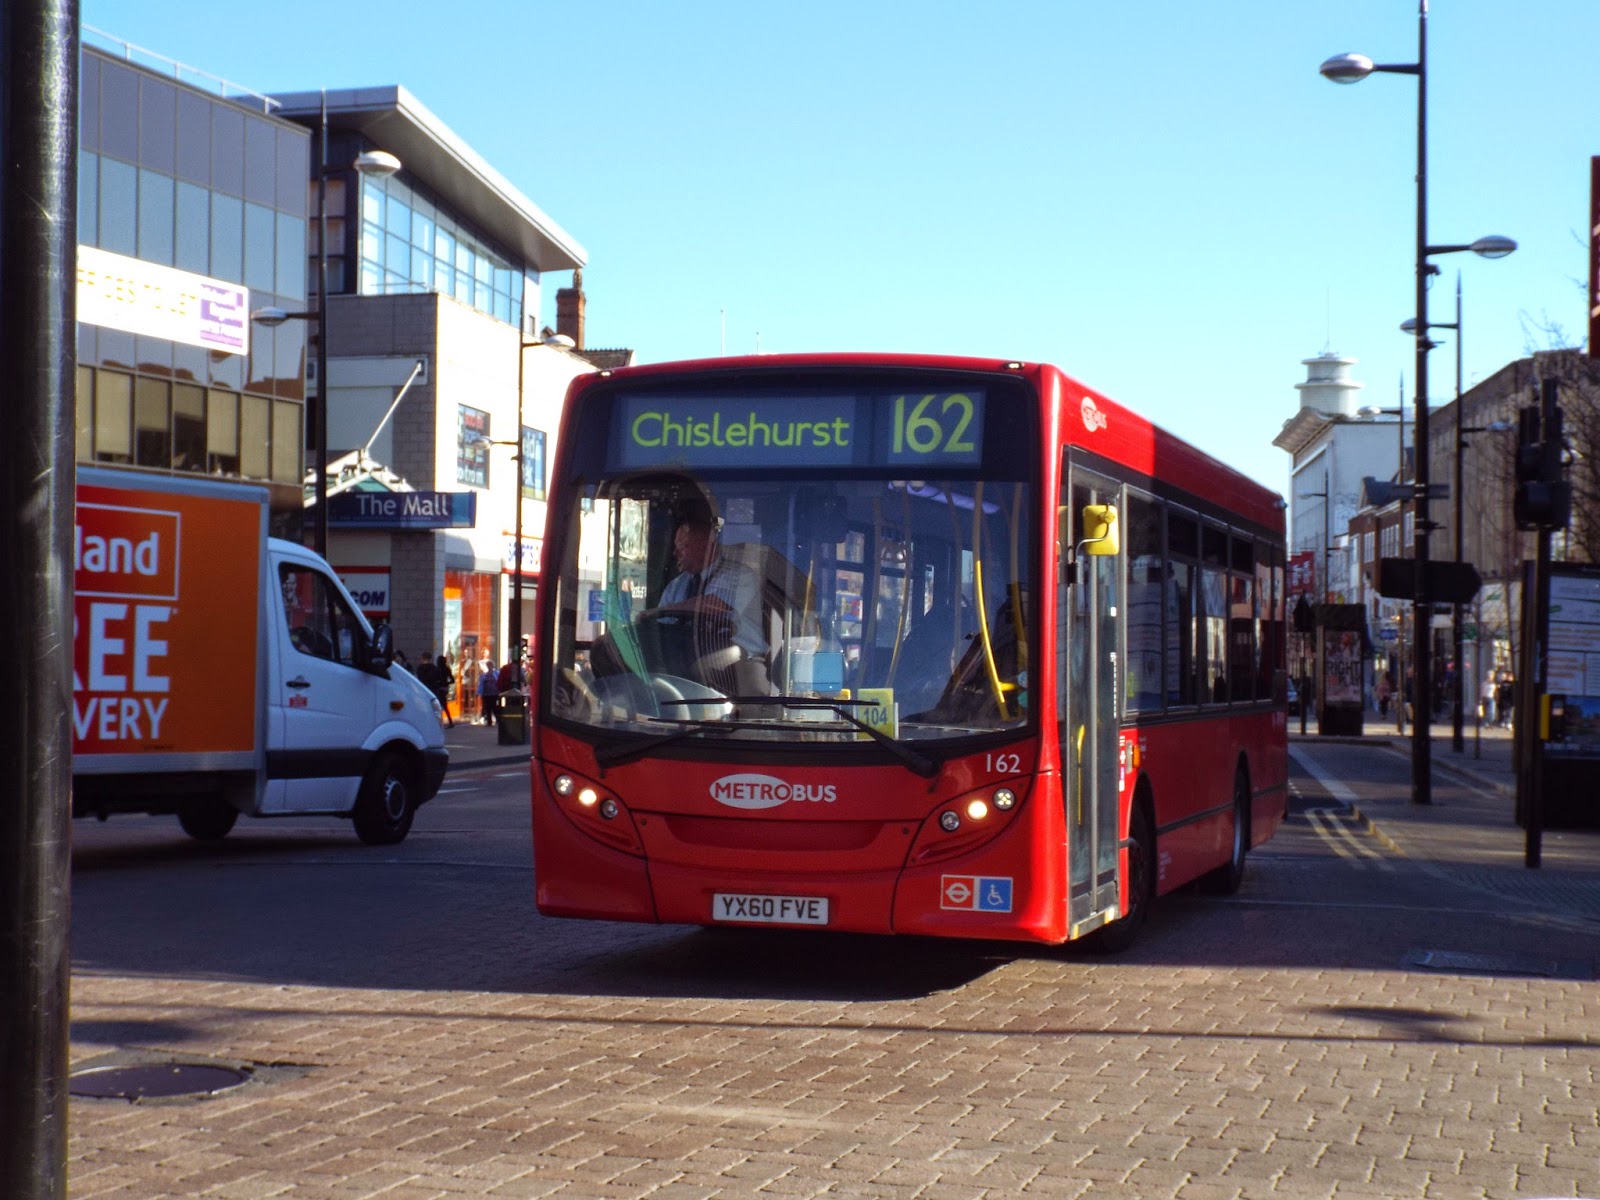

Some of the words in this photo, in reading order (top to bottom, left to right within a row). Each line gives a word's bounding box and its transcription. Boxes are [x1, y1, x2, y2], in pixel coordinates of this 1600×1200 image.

[632, 412, 849, 447] Chislehurst
[893, 394, 974, 453] 162
[356, 494, 396, 515] The
[402, 494, 449, 516] Mall
[73, 602, 171, 692] EE
[863, 706, 888, 727] 104
[985, 753, 1021, 773] 162
[714, 782, 837, 803] METROBUS
[722, 896, 775, 917] YX60
[780, 899, 820, 920] FVE
